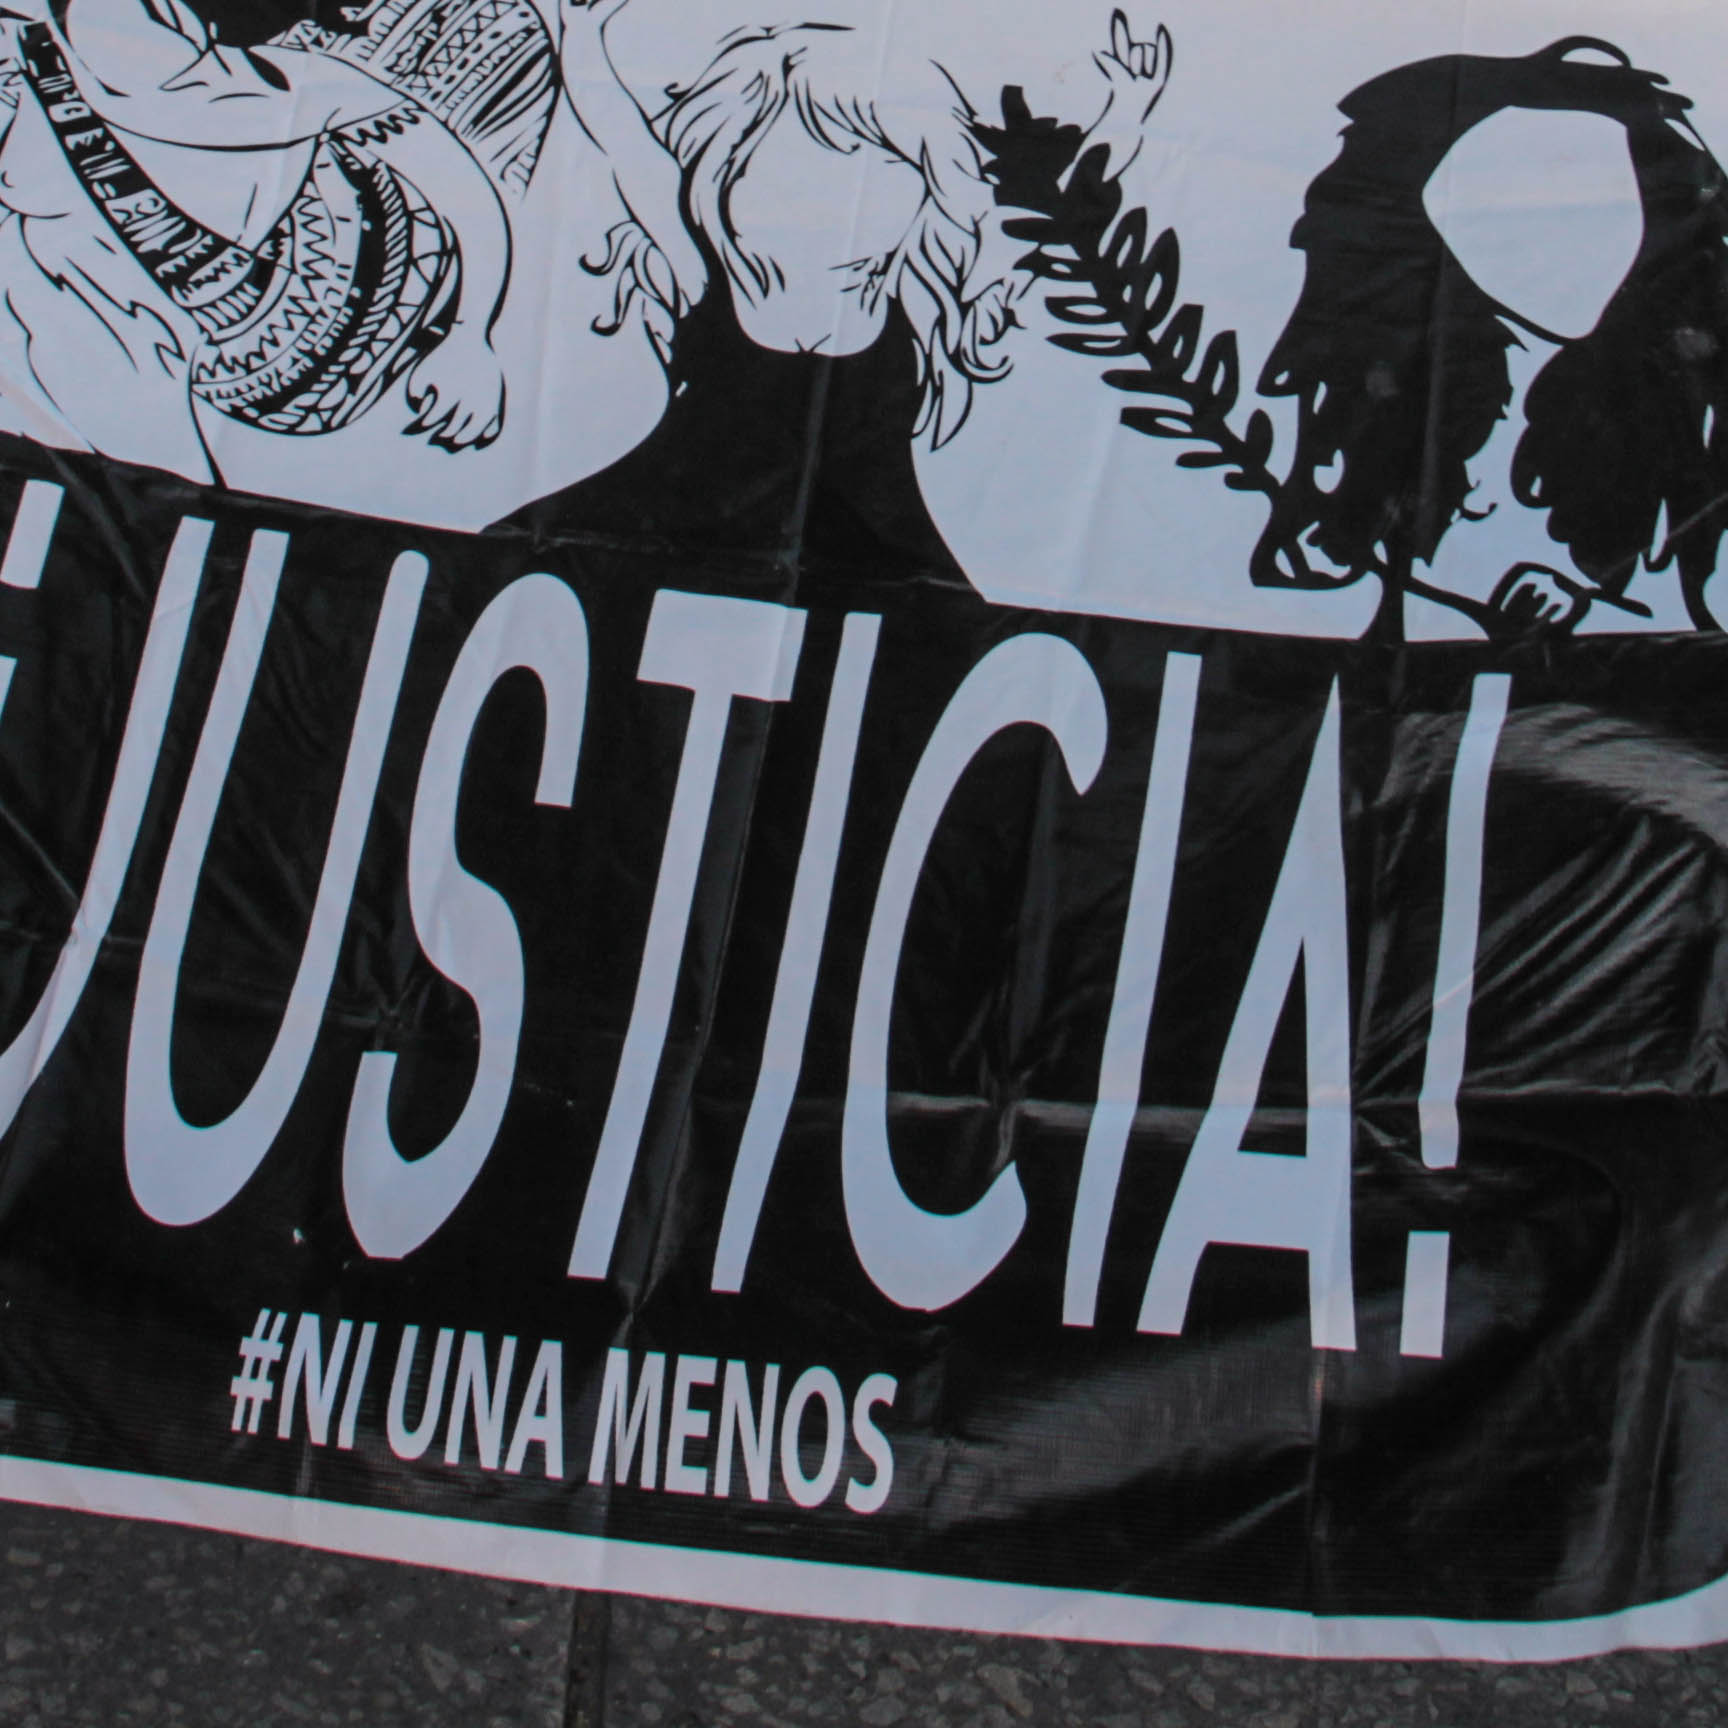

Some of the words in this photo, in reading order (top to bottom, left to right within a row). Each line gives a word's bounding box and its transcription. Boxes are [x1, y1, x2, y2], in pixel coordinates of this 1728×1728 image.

[229, 1308, 377, 1450] #NI
[386, 1325, 564, 1480] UNA
[588, 1347, 898, 1514] MENOS
